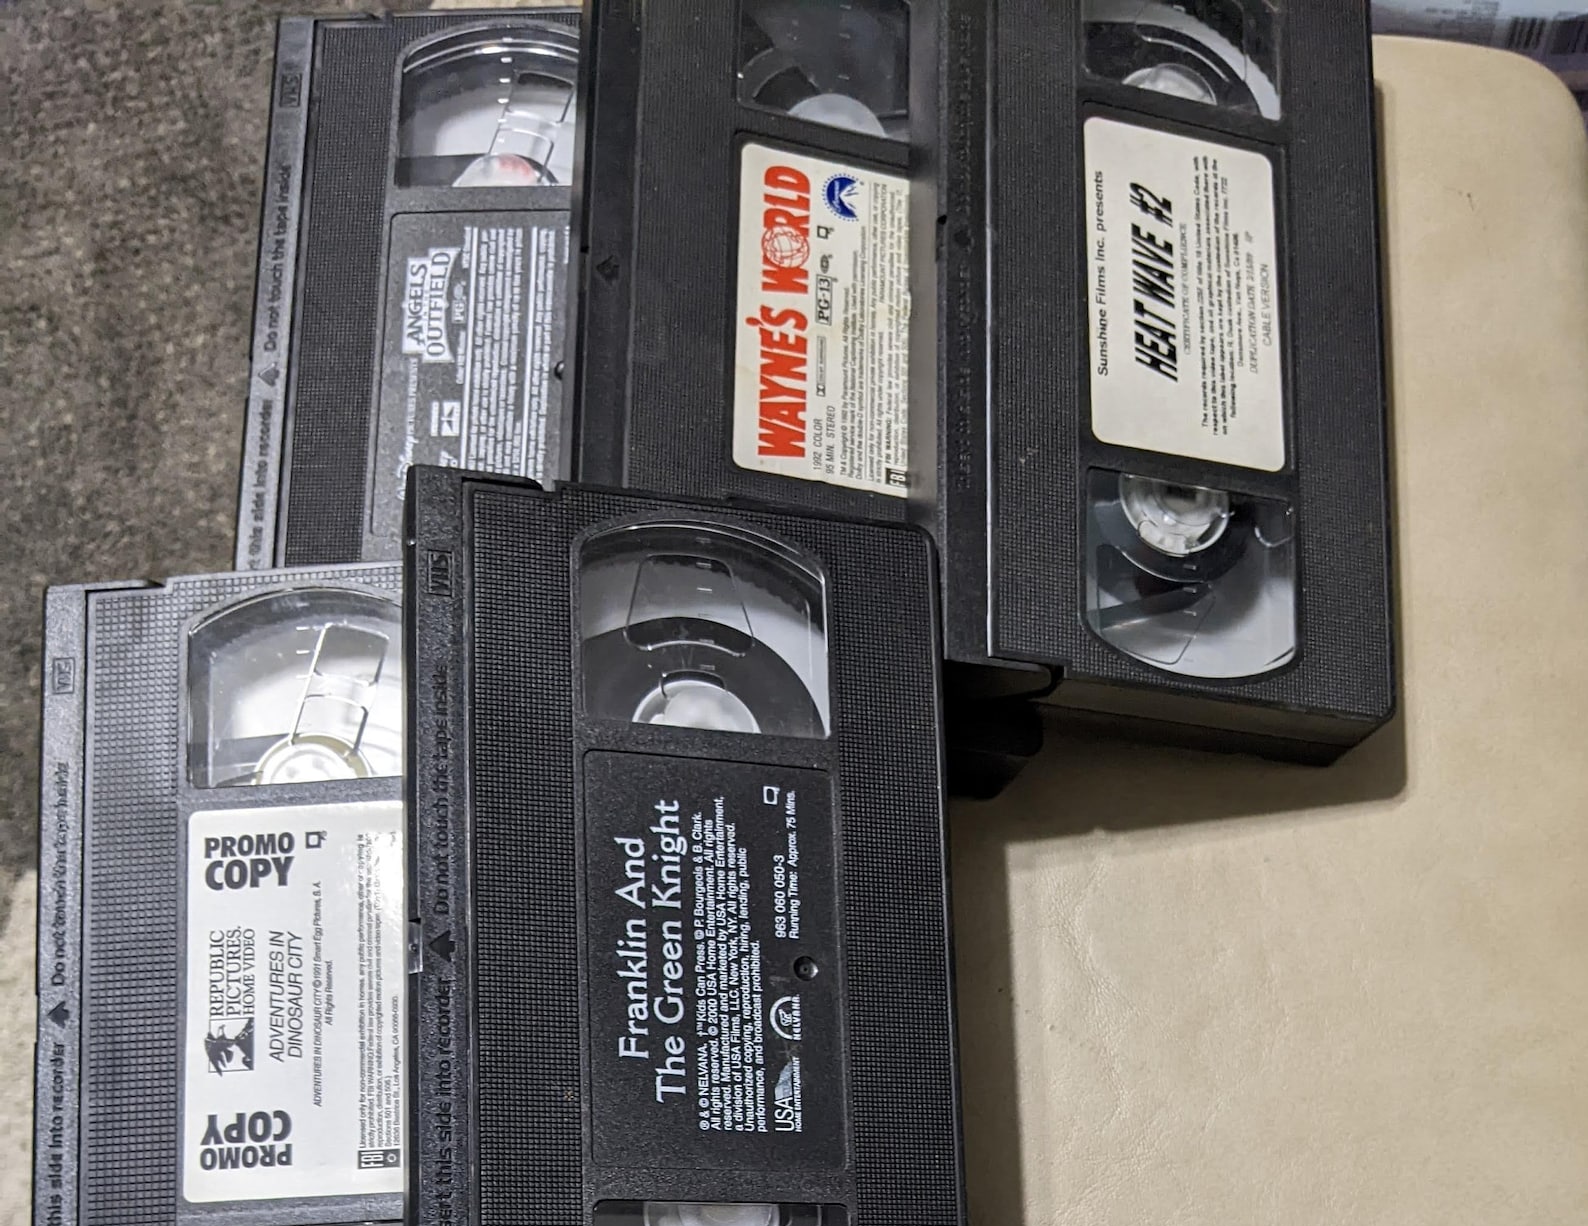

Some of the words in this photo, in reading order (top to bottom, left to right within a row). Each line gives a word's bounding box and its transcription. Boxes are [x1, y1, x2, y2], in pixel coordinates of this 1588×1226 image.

[1094, 171, 1106, 232] presents
[1129, 182, 1173, 227] #2
[761, 165, 811, 294] WORLD
[1095, 238, 1104, 261] Inc.
[1131, 223, 1175, 309] WAVE
[817, 277, 831, 322] PG-13
[1095, 267, 1105, 305] Films
[406, 263, 427, 345] ANGELS
[427, 251, 452, 358] OUTFIELD
[1097, 309, 1108, 376] Sunshine
[1133, 298, 1178, 382] HEAT
[745, 304, 808, 458] WAYNE'S
[812, 419, 823, 448] COLOR
[825, 406, 835, 439] STEREO
[812, 452, 822, 470] 1992
[825, 443, 834, 462] MIN.
[825, 464, 834, 474] 95
[430, 552, 451, 593] VHS
[785, 791, 795, 815] Mins.
[703, 820, 716, 847] rights
[713, 797, 725, 868] Entertainment,
[785, 817, 796, 829] 75
[204, 831, 295, 860] PROMO
[649, 800, 687, 909] Knight
[703, 849, 714, 863] All
[724, 823, 736, 868] reserved.
[736, 848, 749, 877] public
[787, 832, 799, 867] Approx.
[204, 856, 294, 892] COPY
[613, 837, 645, 909] And
[715, 870, 725, 900] Home
[726, 871, 739, 898] rights
[773, 855, 785, 888] 050-3
[787, 872, 798, 898] Time:
[704, 865, 715, 937] Entertainment.
[715, 903, 726, 926] USA
[727, 901, 737, 915] All
[737, 880, 750, 919] lending,
[774, 891, 785, 913] 060
[716, 929, 728, 941] by
[727, 917, 737, 933] NY.
[738, 922, 751, 952] hiring,
[774, 916, 786, 938] 963
[788, 900, 800, 939] Running
[242, 929, 255, 972] VIDEO
[269, 931, 284, 947] IN
[287, 932, 302, 969] CITY
[706, 940, 716, 970] Home
[727, 937, 741, 961] York,
[209, 930, 225, 1017] REPUBLIC
[324, 961, 332, 993] Reserved.
[653, 921, 683, 1024] Green
[717, 944, 728, 990] marketed
[728, 963, 741, 985] New
[749, 941, 763, 992] prohibited.
[243, 975, 254, 1016] HOME
[616, 920, 648, 1059] Franklin
[706, 973, 717, 996] USA
[718, 991, 731, 1012] and
[729, 987, 742, 1011] LLC.
[739, 955, 752, 1019] reproduction,
[269, 951, 284, 1063] ADVENTURES
[287, 973, 303, 1058] DINOSAUR
[324, 994, 335, 1016] Rights
[324, 1016, 332, 1026] All
[432, 976, 455, 1055] recorder
[707, 999, 718, 1024] 2000
[751, 994, 762, 1043] broadcast
[707, 1026, 718, 1036] ©
[730, 1014, 740, 1043] Films,
[741, 1023, 754, 1064] copying,
[708, 1038, 720, 1084] reserved.
[718, 1014, 732, 1082] Manufactured
[730, 1046, 741, 1069] USA
[753, 1046, 763, 1065] and
[49, 1042, 64, 1112] recorder
[433, 1058, 455, 1097] into
[655, 1036, 686, 1103] The
[731, 1072, 742, 1082] of
[792, 1057, 801, 1111] ENTERTAINMENT
[710, 1087, 723, 1115] rights
[721, 1085, 732, 1131] reserved.
[732, 1085, 743, 1122] division
[742, 1066, 754, 1132] Unauthorized
[755, 1068, 768, 1132] performance,
[774, 1097, 795, 1132] USA
[47, 1116, 63, 1149] into
[200, 1110, 292, 1145] COPY
[433, 1101, 452, 1143] side
[710, 1117, 721, 1131] All
[794, 1112, 802, 1132] HOME
[47, 1154, 63, 1189] side
[200, 1143, 293, 1170] PROMO
[361, 1150, 385, 1168] FBI
[432, 1145, 456, 1189] this
